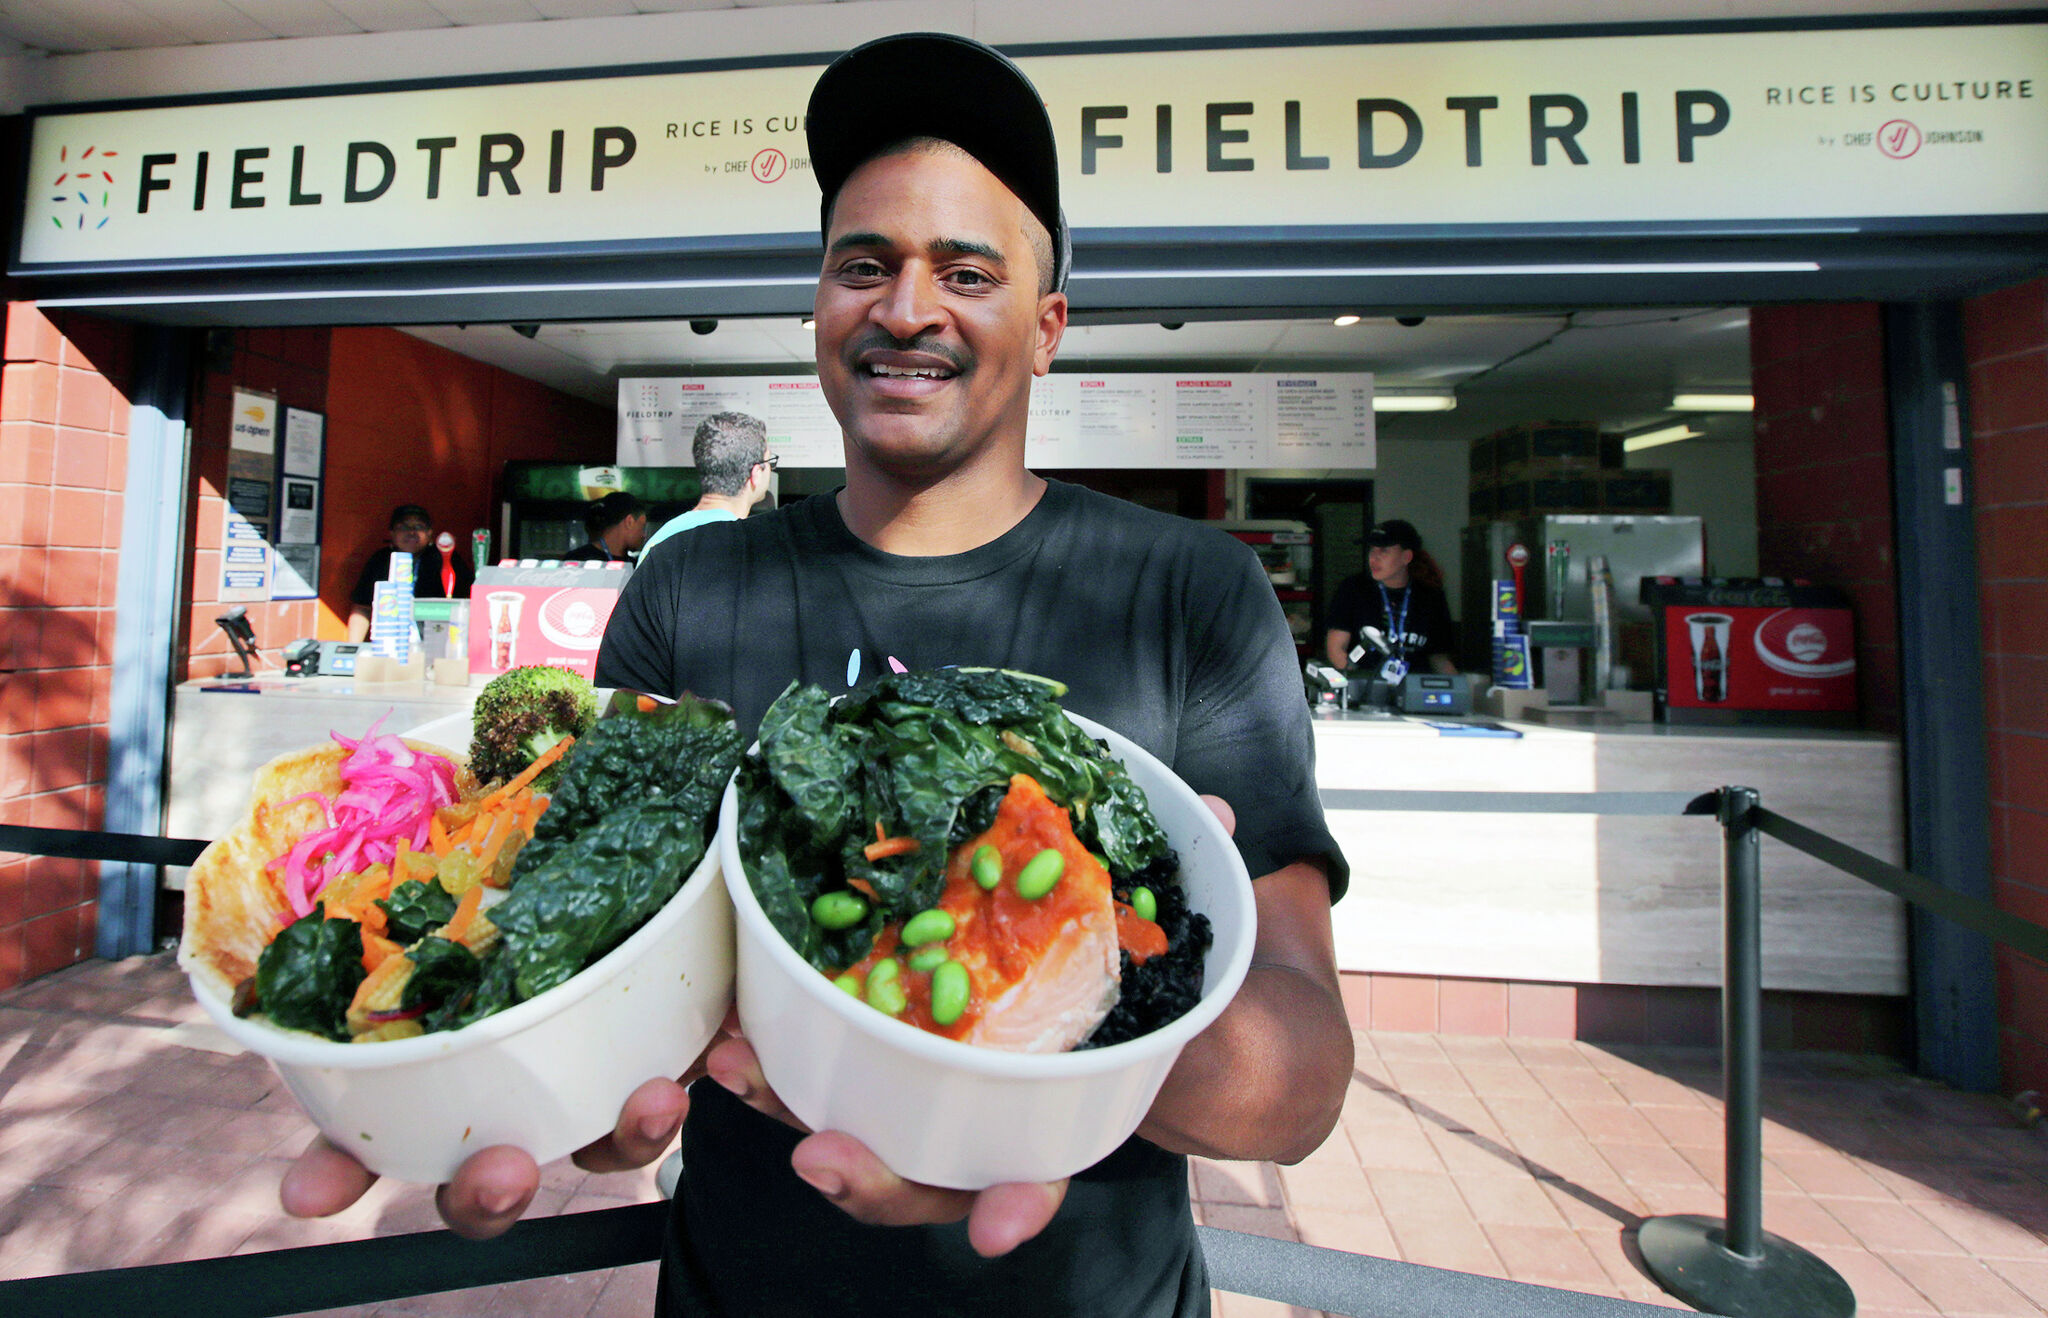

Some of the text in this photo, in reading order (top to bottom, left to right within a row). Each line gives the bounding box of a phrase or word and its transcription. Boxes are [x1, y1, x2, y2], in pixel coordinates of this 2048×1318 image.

[1767, 80, 2034, 105] RICE IS CULTURE
[666, 121, 721, 139] RICE
[733, 118, 753, 135] IS
[1081, 90, 1731, 175] FIELDTRIP
[1844, 132, 1873, 146] CHEF
[1925, 130, 1984, 145] JOHNSON
[136, 126, 638, 214] FIELDTRIP
[705, 165, 717, 175] by
[724, 160, 748, 173] CHEF
[626, 411, 673, 419] FIELDTRIP
[234, 424, 271, 437] us open
